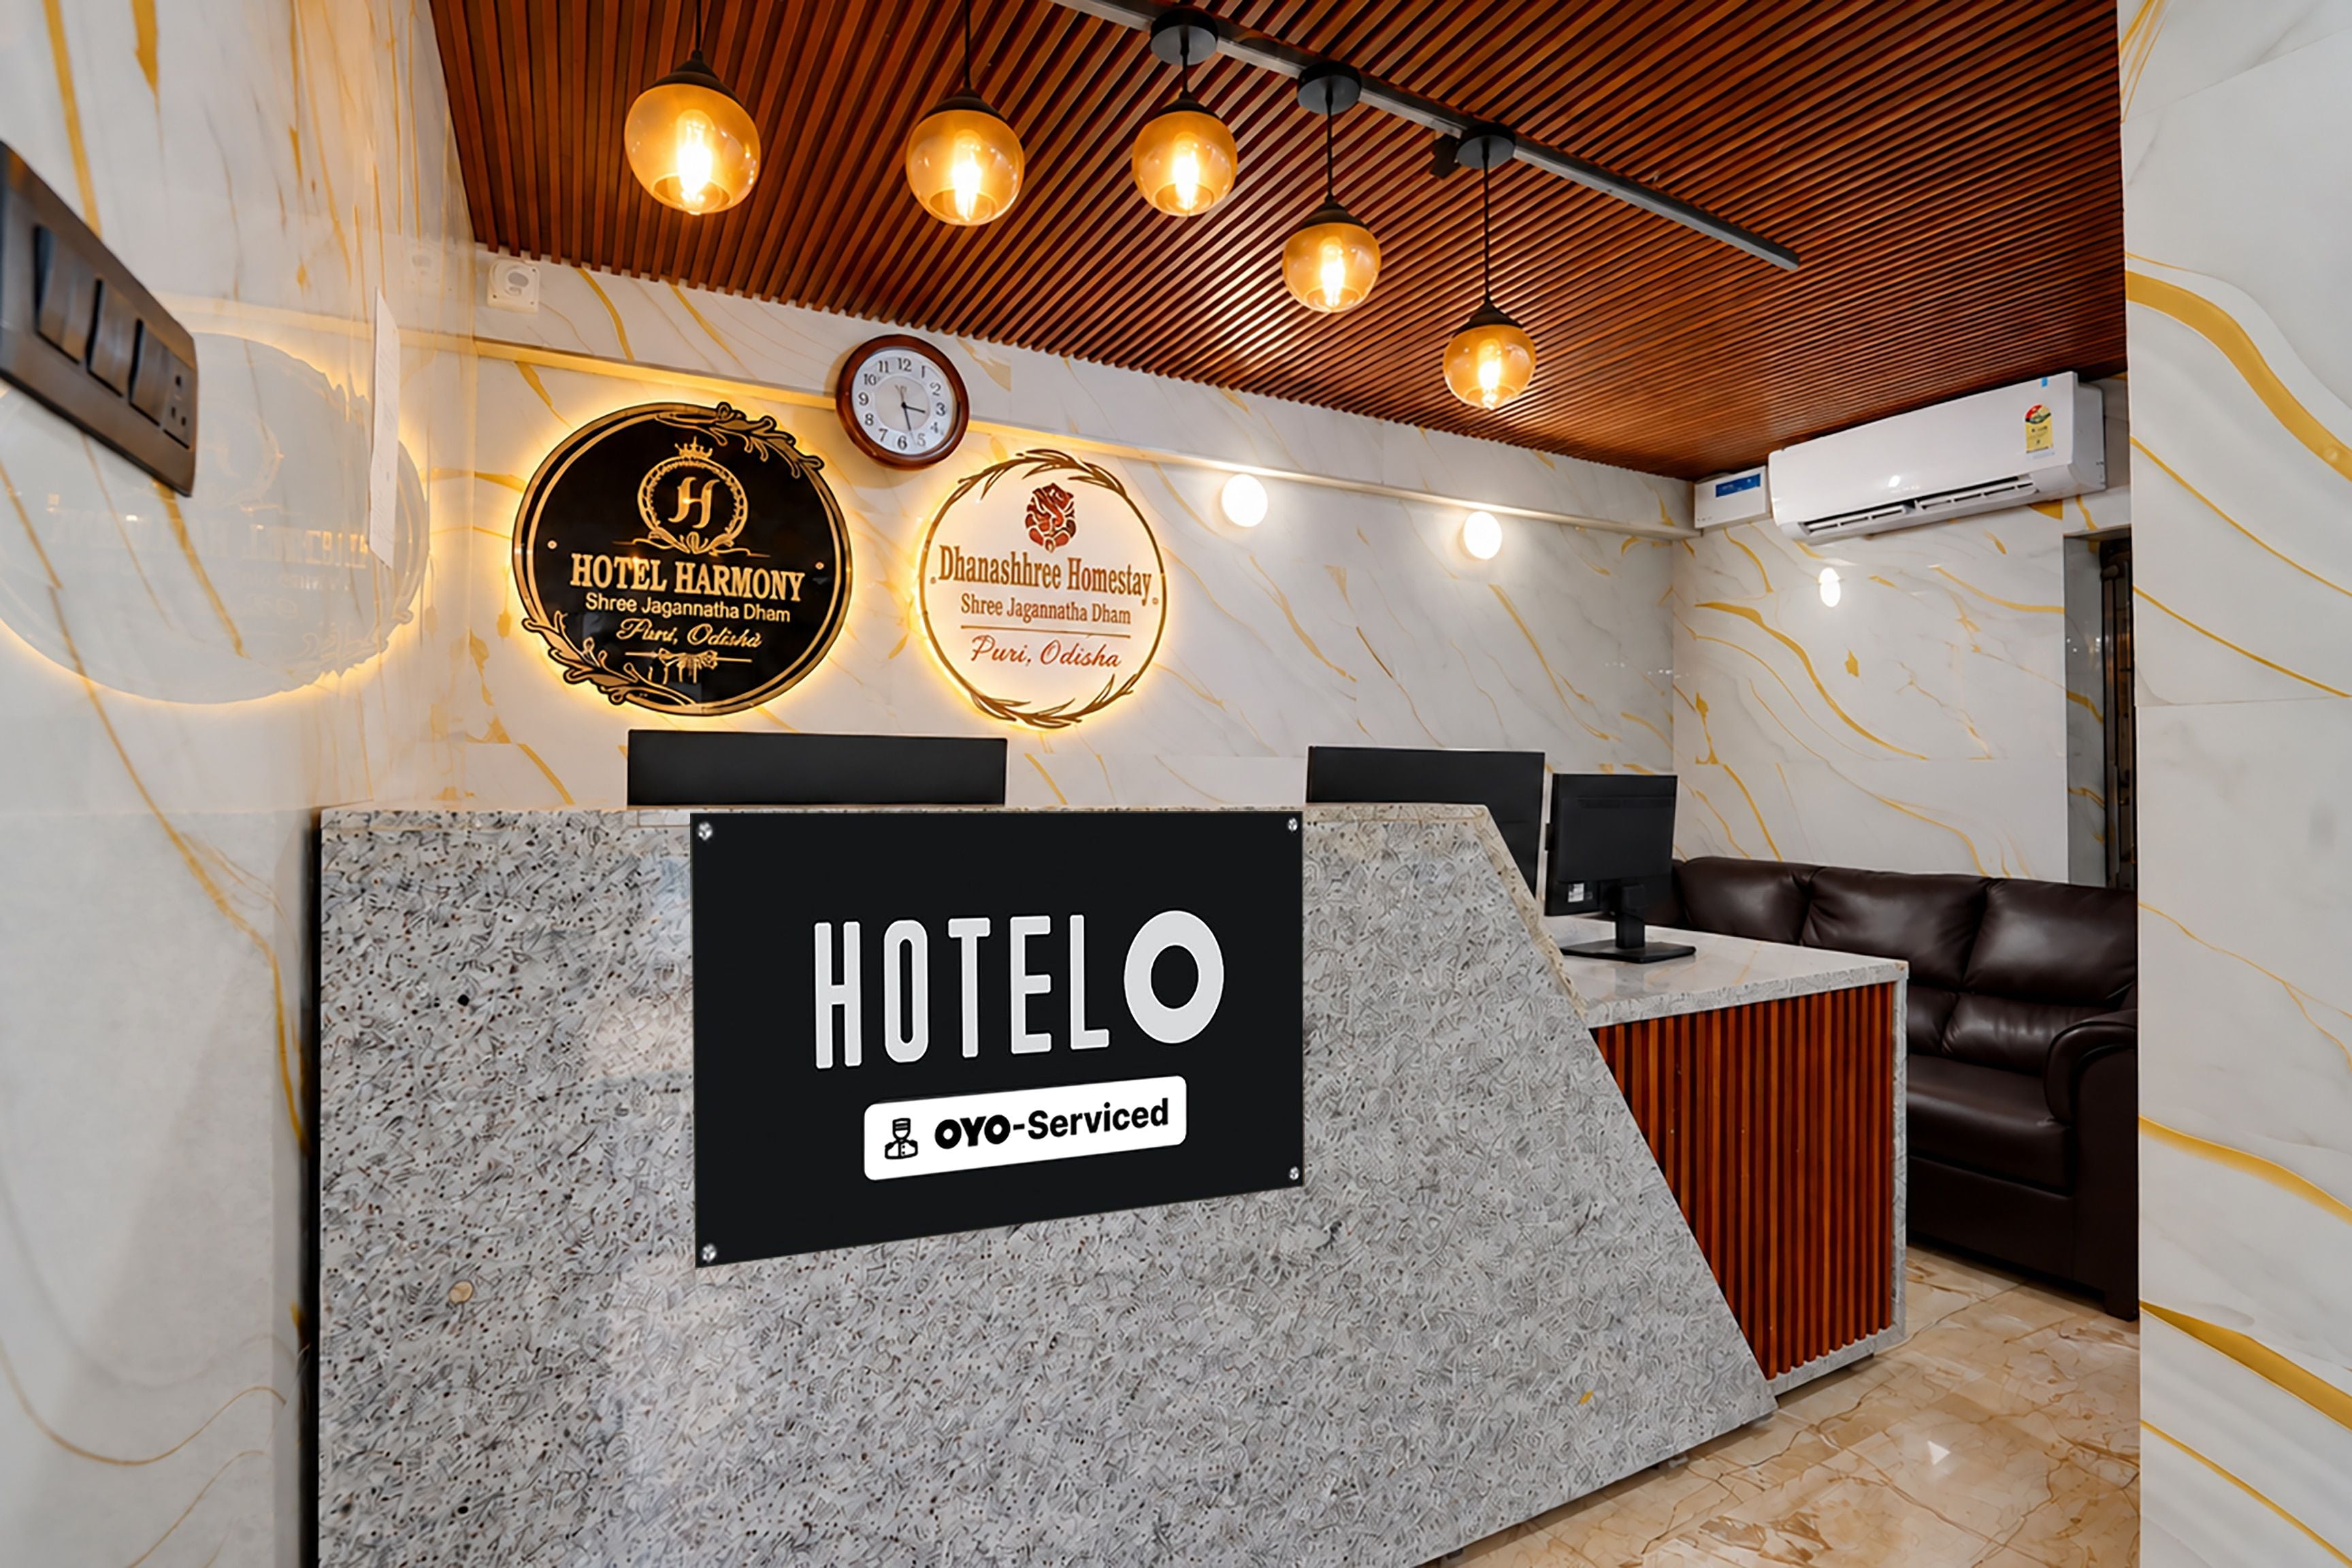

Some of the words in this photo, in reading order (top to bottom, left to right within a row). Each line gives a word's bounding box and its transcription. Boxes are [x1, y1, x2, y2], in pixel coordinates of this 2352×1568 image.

[879, 360, 889, 373] 11
[898, 358, 912, 372] 12
[921, 365, 925, 378] 1
[864, 374, 877, 385] 10
[930, 382, 941, 396] 2
[858, 392, 869, 406] 9
[936, 402, 946, 416] 3
[865, 413, 874, 426] 8
[879, 428, 888, 442] 7
[917, 433, 926, 446] 5
[898, 436, 907, 450] 6
[668, 476, 720, 529] H
[570, 553, 667, 591] HOTEL
[674, 561, 805, 602] HARMONY
[938, 545, 1061, 590] Dhanashhree
[1067, 557, 1152, 606] Homestay
[586, 593, 637, 612] Shree
[642, 597, 739, 619] Jagannatha
[743, 604, 790, 622] Dham
[961, 593, 1002, 616] Shree
[1007, 598, 1087, 623] Jagannatha
[1092, 604, 1131, 624] Dham
[616, 618, 679, 644] Puri,
[687, 623, 763, 648] Odisha
[970, 635, 1032, 667] Puri,
[1041, 639, 1122, 668] Odisha
[814, 914, 1109, 1069] HOTEL
[934, 1097, 1169, 1149] OYO-Serviced
